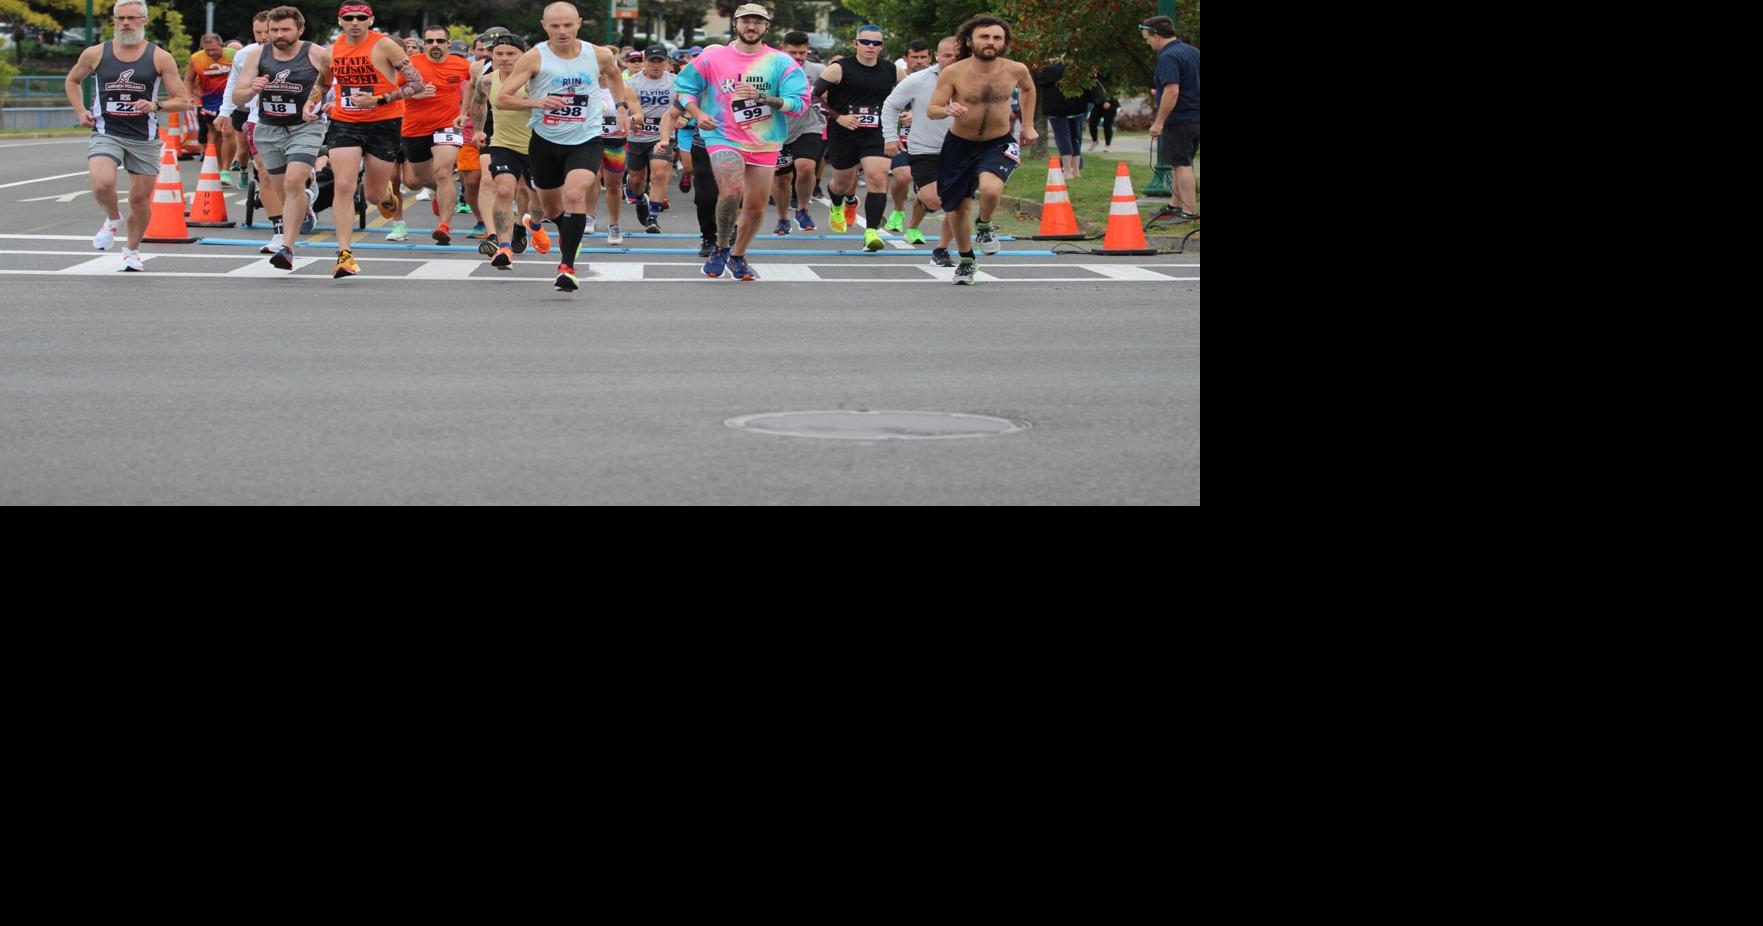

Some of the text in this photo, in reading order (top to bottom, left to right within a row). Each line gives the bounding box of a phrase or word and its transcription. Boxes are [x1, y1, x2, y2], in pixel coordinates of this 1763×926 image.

[334, 56, 369, 66] STATE
[331, 65, 375, 75] PRISON
[562, 78, 582, 87] RUN
[640, 96, 670, 106] PIG
[116, 103, 135, 112] 22
[270, 104, 287, 112] 18
[743, 108, 763, 120] 99
[860, 115, 875, 123] 29
[445, 134, 454, 142] 5
